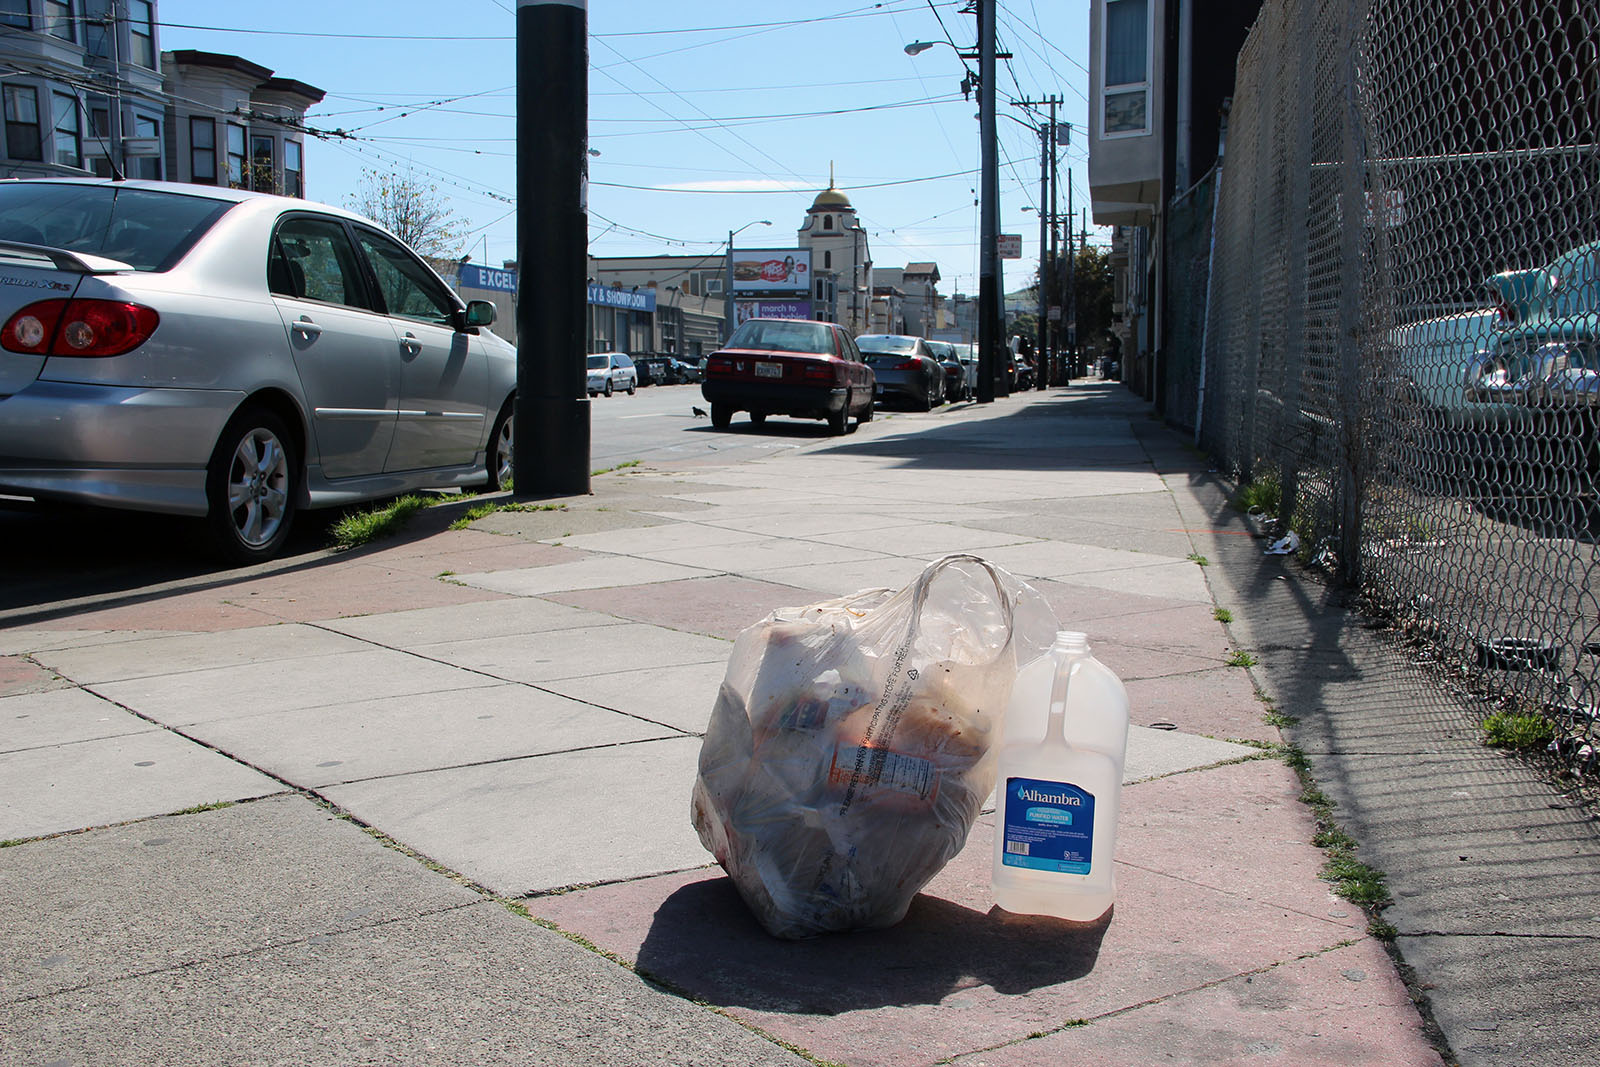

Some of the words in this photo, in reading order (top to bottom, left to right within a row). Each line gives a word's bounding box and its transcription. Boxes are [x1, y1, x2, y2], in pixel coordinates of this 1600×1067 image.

[39, 279, 73, 291] XRS
[598, 286, 605, 301] &
[606, 289, 647, 308] SHOWROOM
[761, 304, 787, 312] march
[862, 697, 889, 745] PARTICIPATING
[883, 675, 897, 699] STORE
[891, 659, 904, 679] FOR
[1022, 789, 1081, 806] Alhambra
[1029, 812, 1051, 820] PURIFIED
[1051, 814, 1070, 822] WATER
